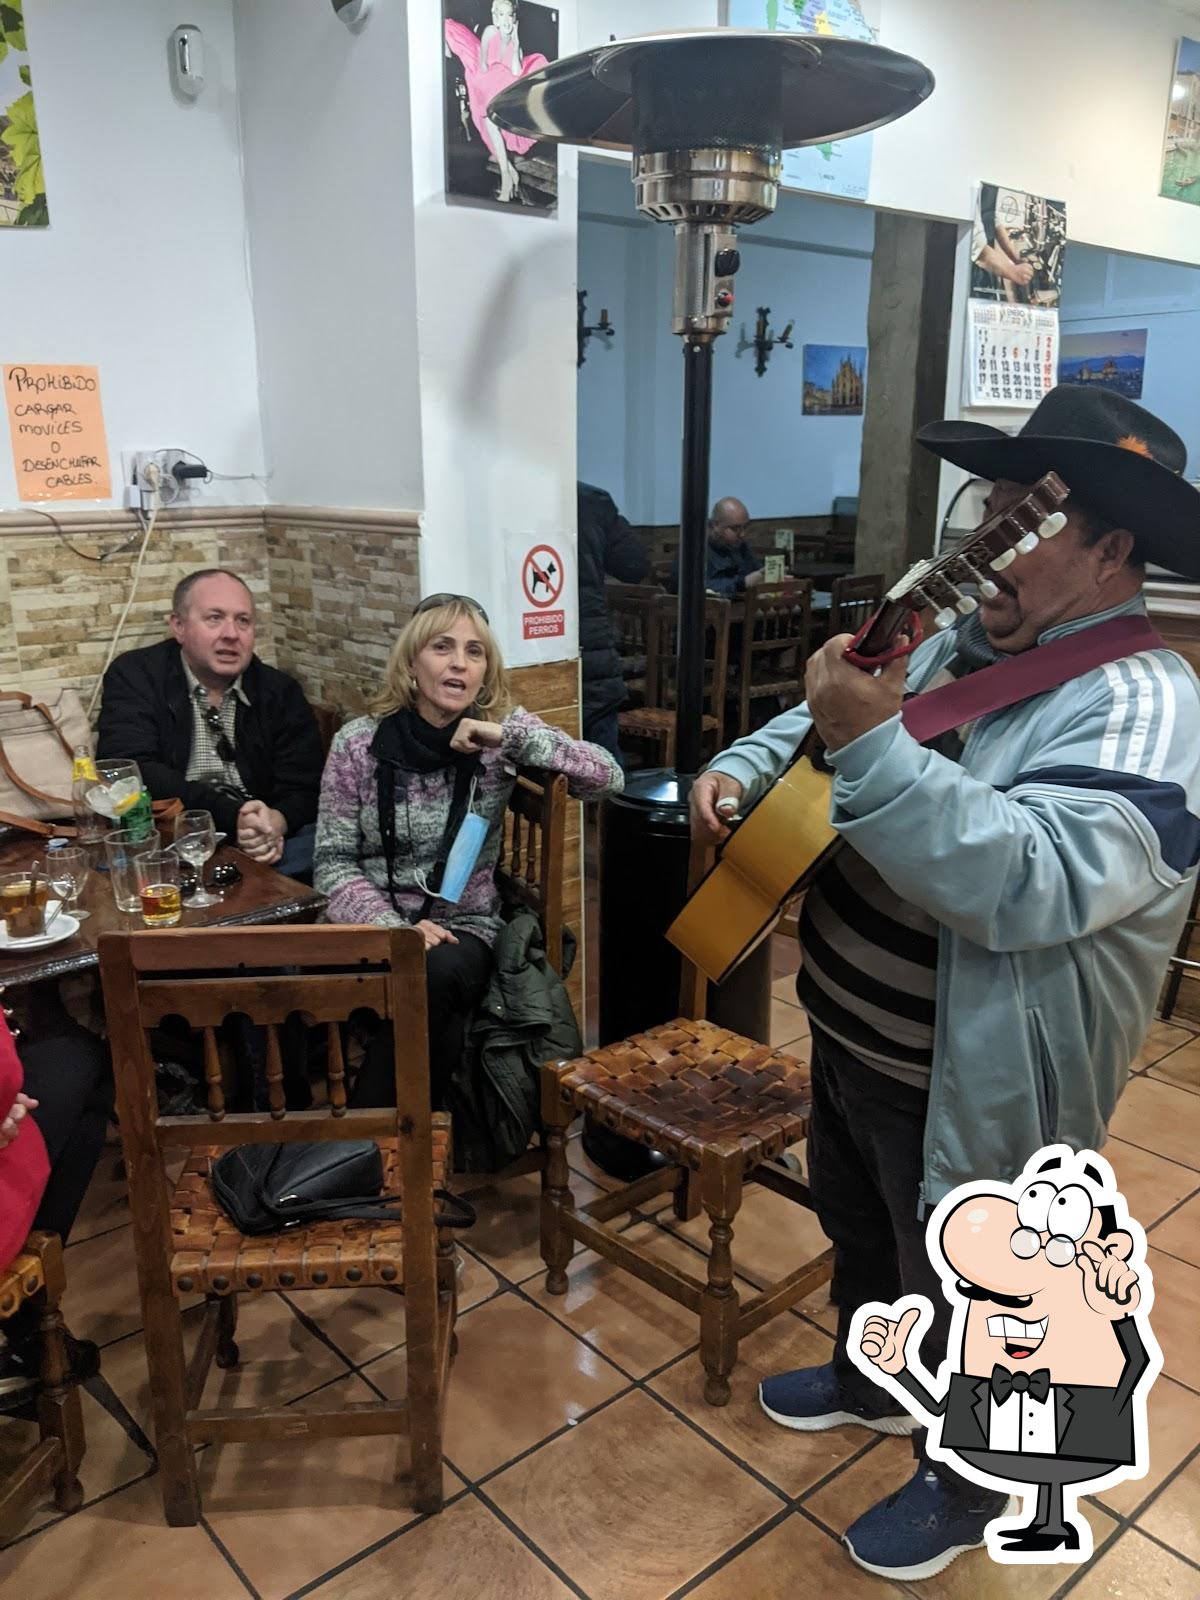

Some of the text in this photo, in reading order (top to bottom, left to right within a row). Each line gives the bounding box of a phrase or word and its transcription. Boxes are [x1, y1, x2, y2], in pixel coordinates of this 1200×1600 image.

[1046, 336, 1052, 348] 2
[980, 344, 1052, 362] 3 4 5 6 7 8 9
[979, 359, 1052, 375] 10 11 12 13 14 15 16
[9, 367, 96, 394] PROHIBIDO
[979, 373, 1052, 388] 17 18 19 20 21 22 23
[991, 387, 1000, 399] 25
[1003, 387, 1012, 399] 26
[1015, 388, 1022, 399] 27
[1025, 389, 1032, 400] 28
[15, 403, 77, 420] CARGAR
[50, 441, 61, 454] O
[524, 613, 563, 625] PROHIBIDO
[529, 624, 559, 635] PERROS
